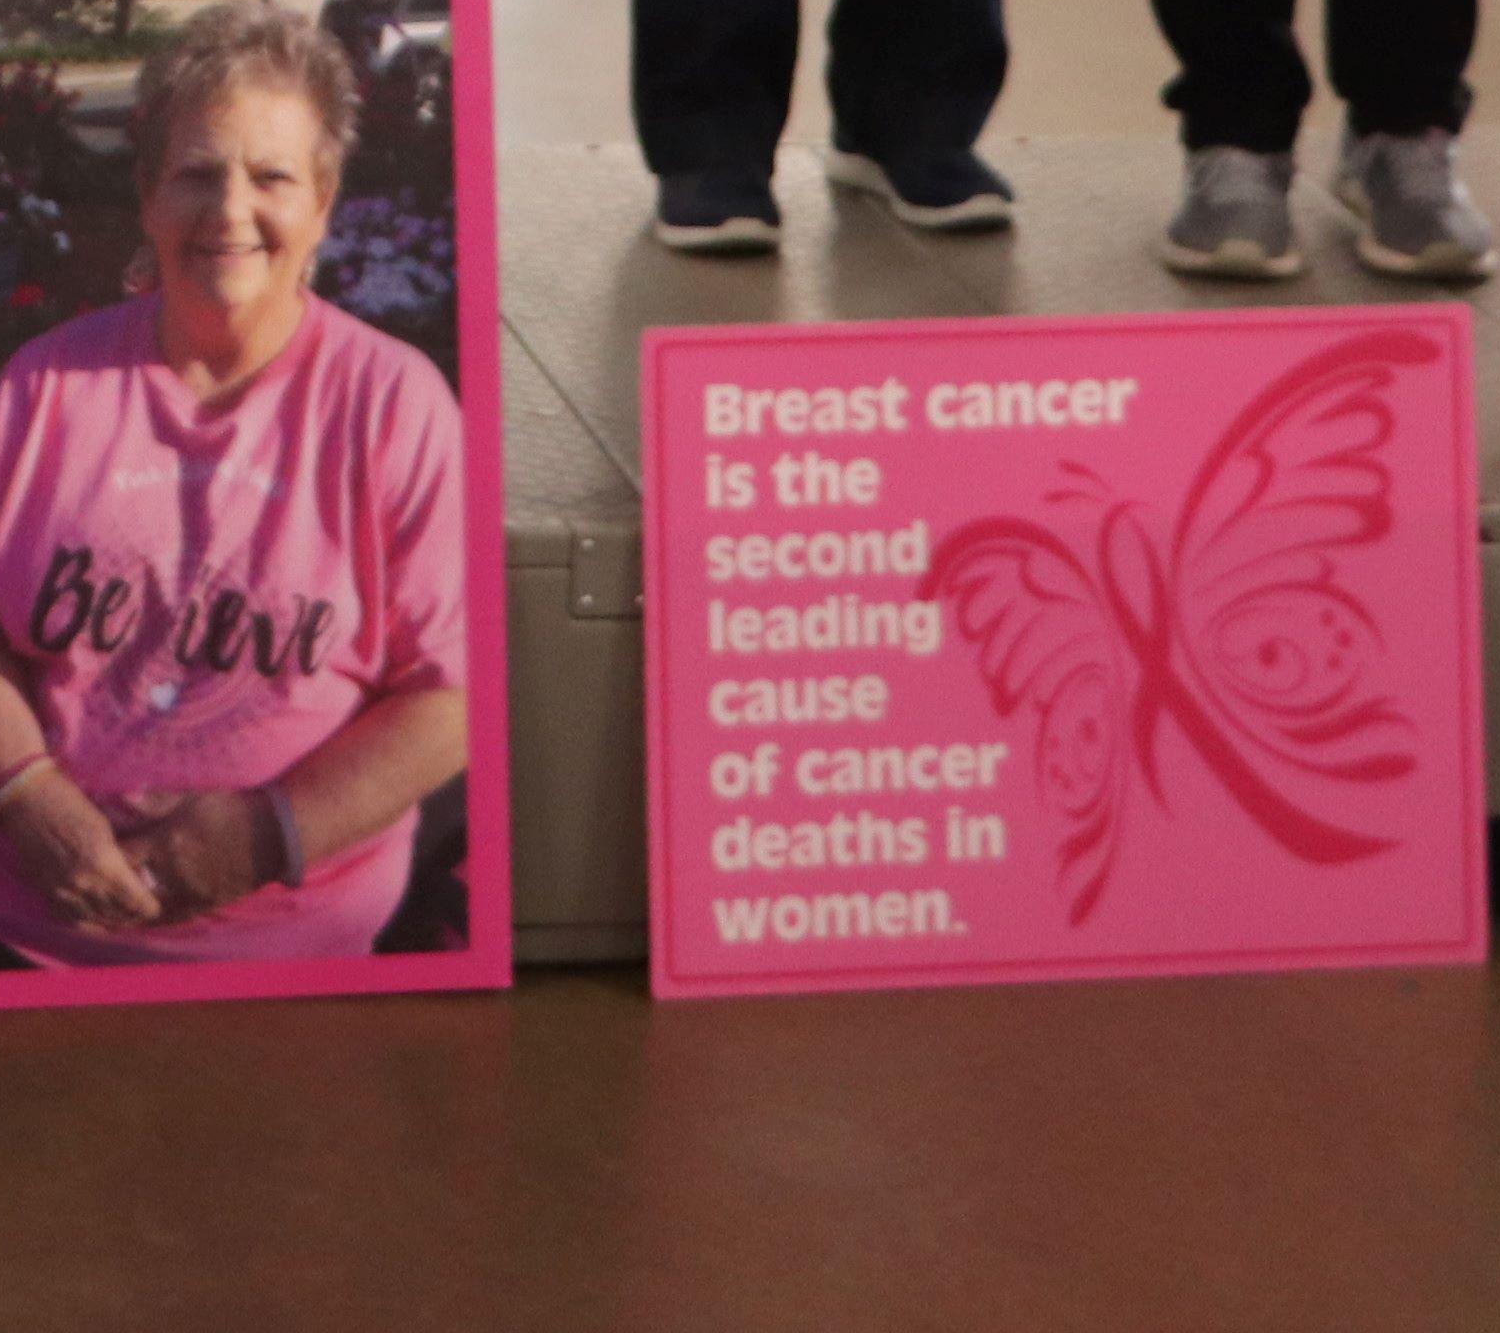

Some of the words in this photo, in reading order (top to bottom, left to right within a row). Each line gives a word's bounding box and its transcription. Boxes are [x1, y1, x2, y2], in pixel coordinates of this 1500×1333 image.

[703, 379, 909, 436] Breast
[927, 375, 1138, 428] cancer
[706, 453, 756, 508] is
[772, 451, 882, 506] the
[706, 520, 930, 580] second
[708, 596, 942, 655] leading
[709, 673, 888, 725] cause
[710, 742, 780, 799] of
[796, 739, 1009, 796] cancer
[711, 812, 928, 871] deaths
[946, 808, 1006, 861] in
[713, 887, 968, 943] women.
